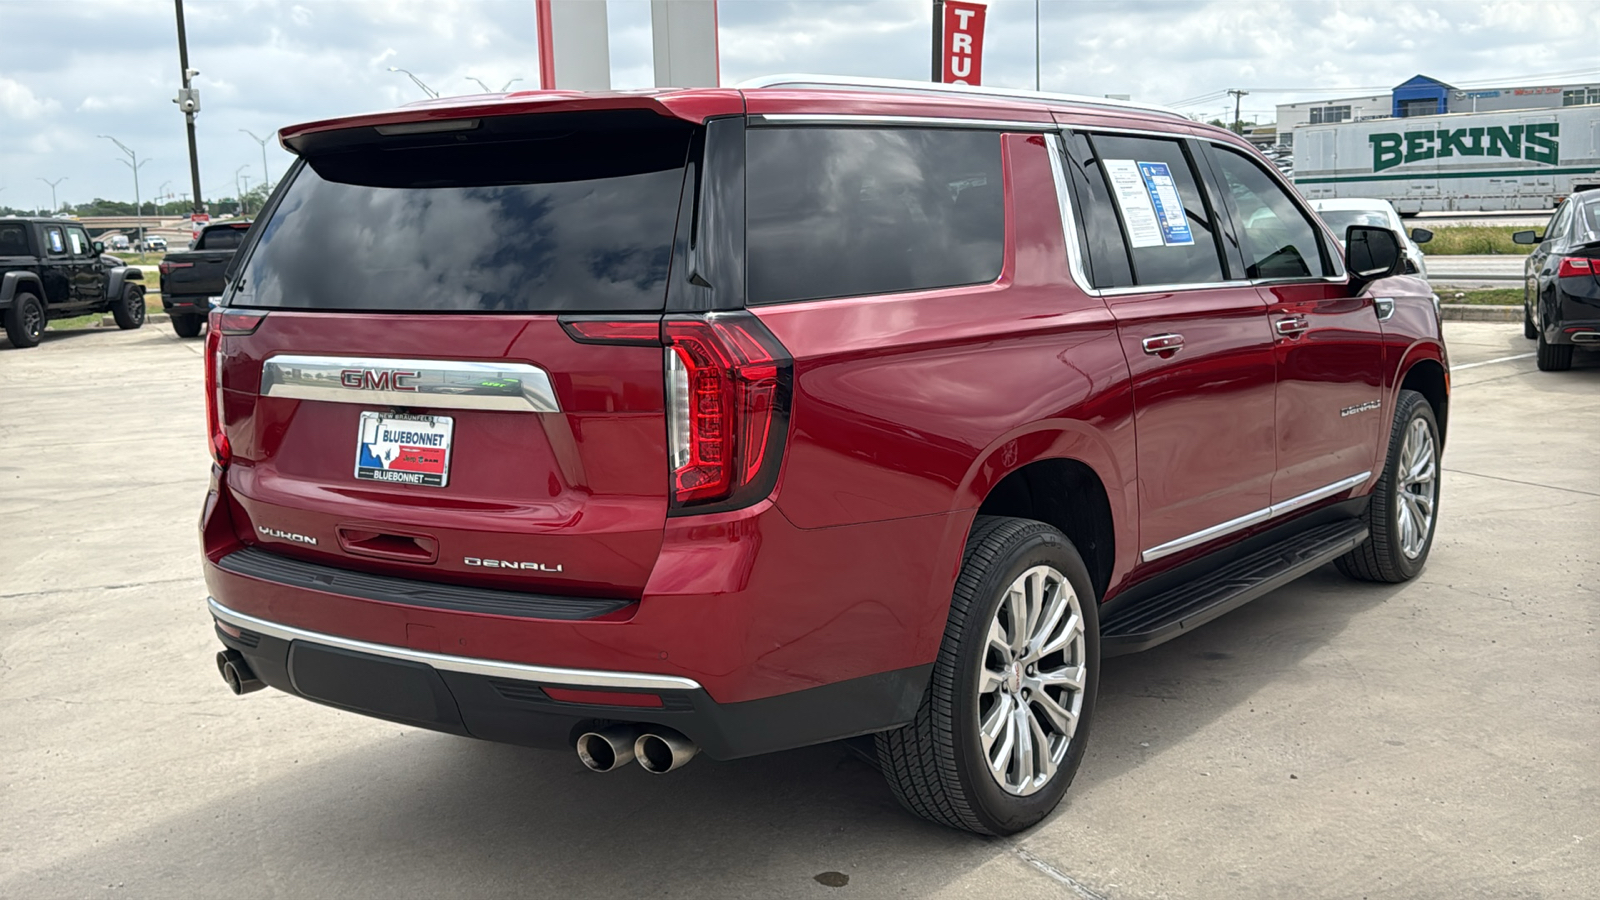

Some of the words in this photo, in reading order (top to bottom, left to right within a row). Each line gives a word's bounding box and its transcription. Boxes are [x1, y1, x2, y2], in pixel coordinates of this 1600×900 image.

[951, 8, 975, 86] TRU
[1369, 122, 1559, 173] BEKINS
[340, 369, 421, 392] GMC
[1341, 399, 1381, 417] DENALI
[382, 430, 444, 446] BLUEBONNET
[373, 470, 424, 483] BLUEBONNET
[258, 525, 318, 546] YUKON
[463, 556, 564, 573] DENALI
